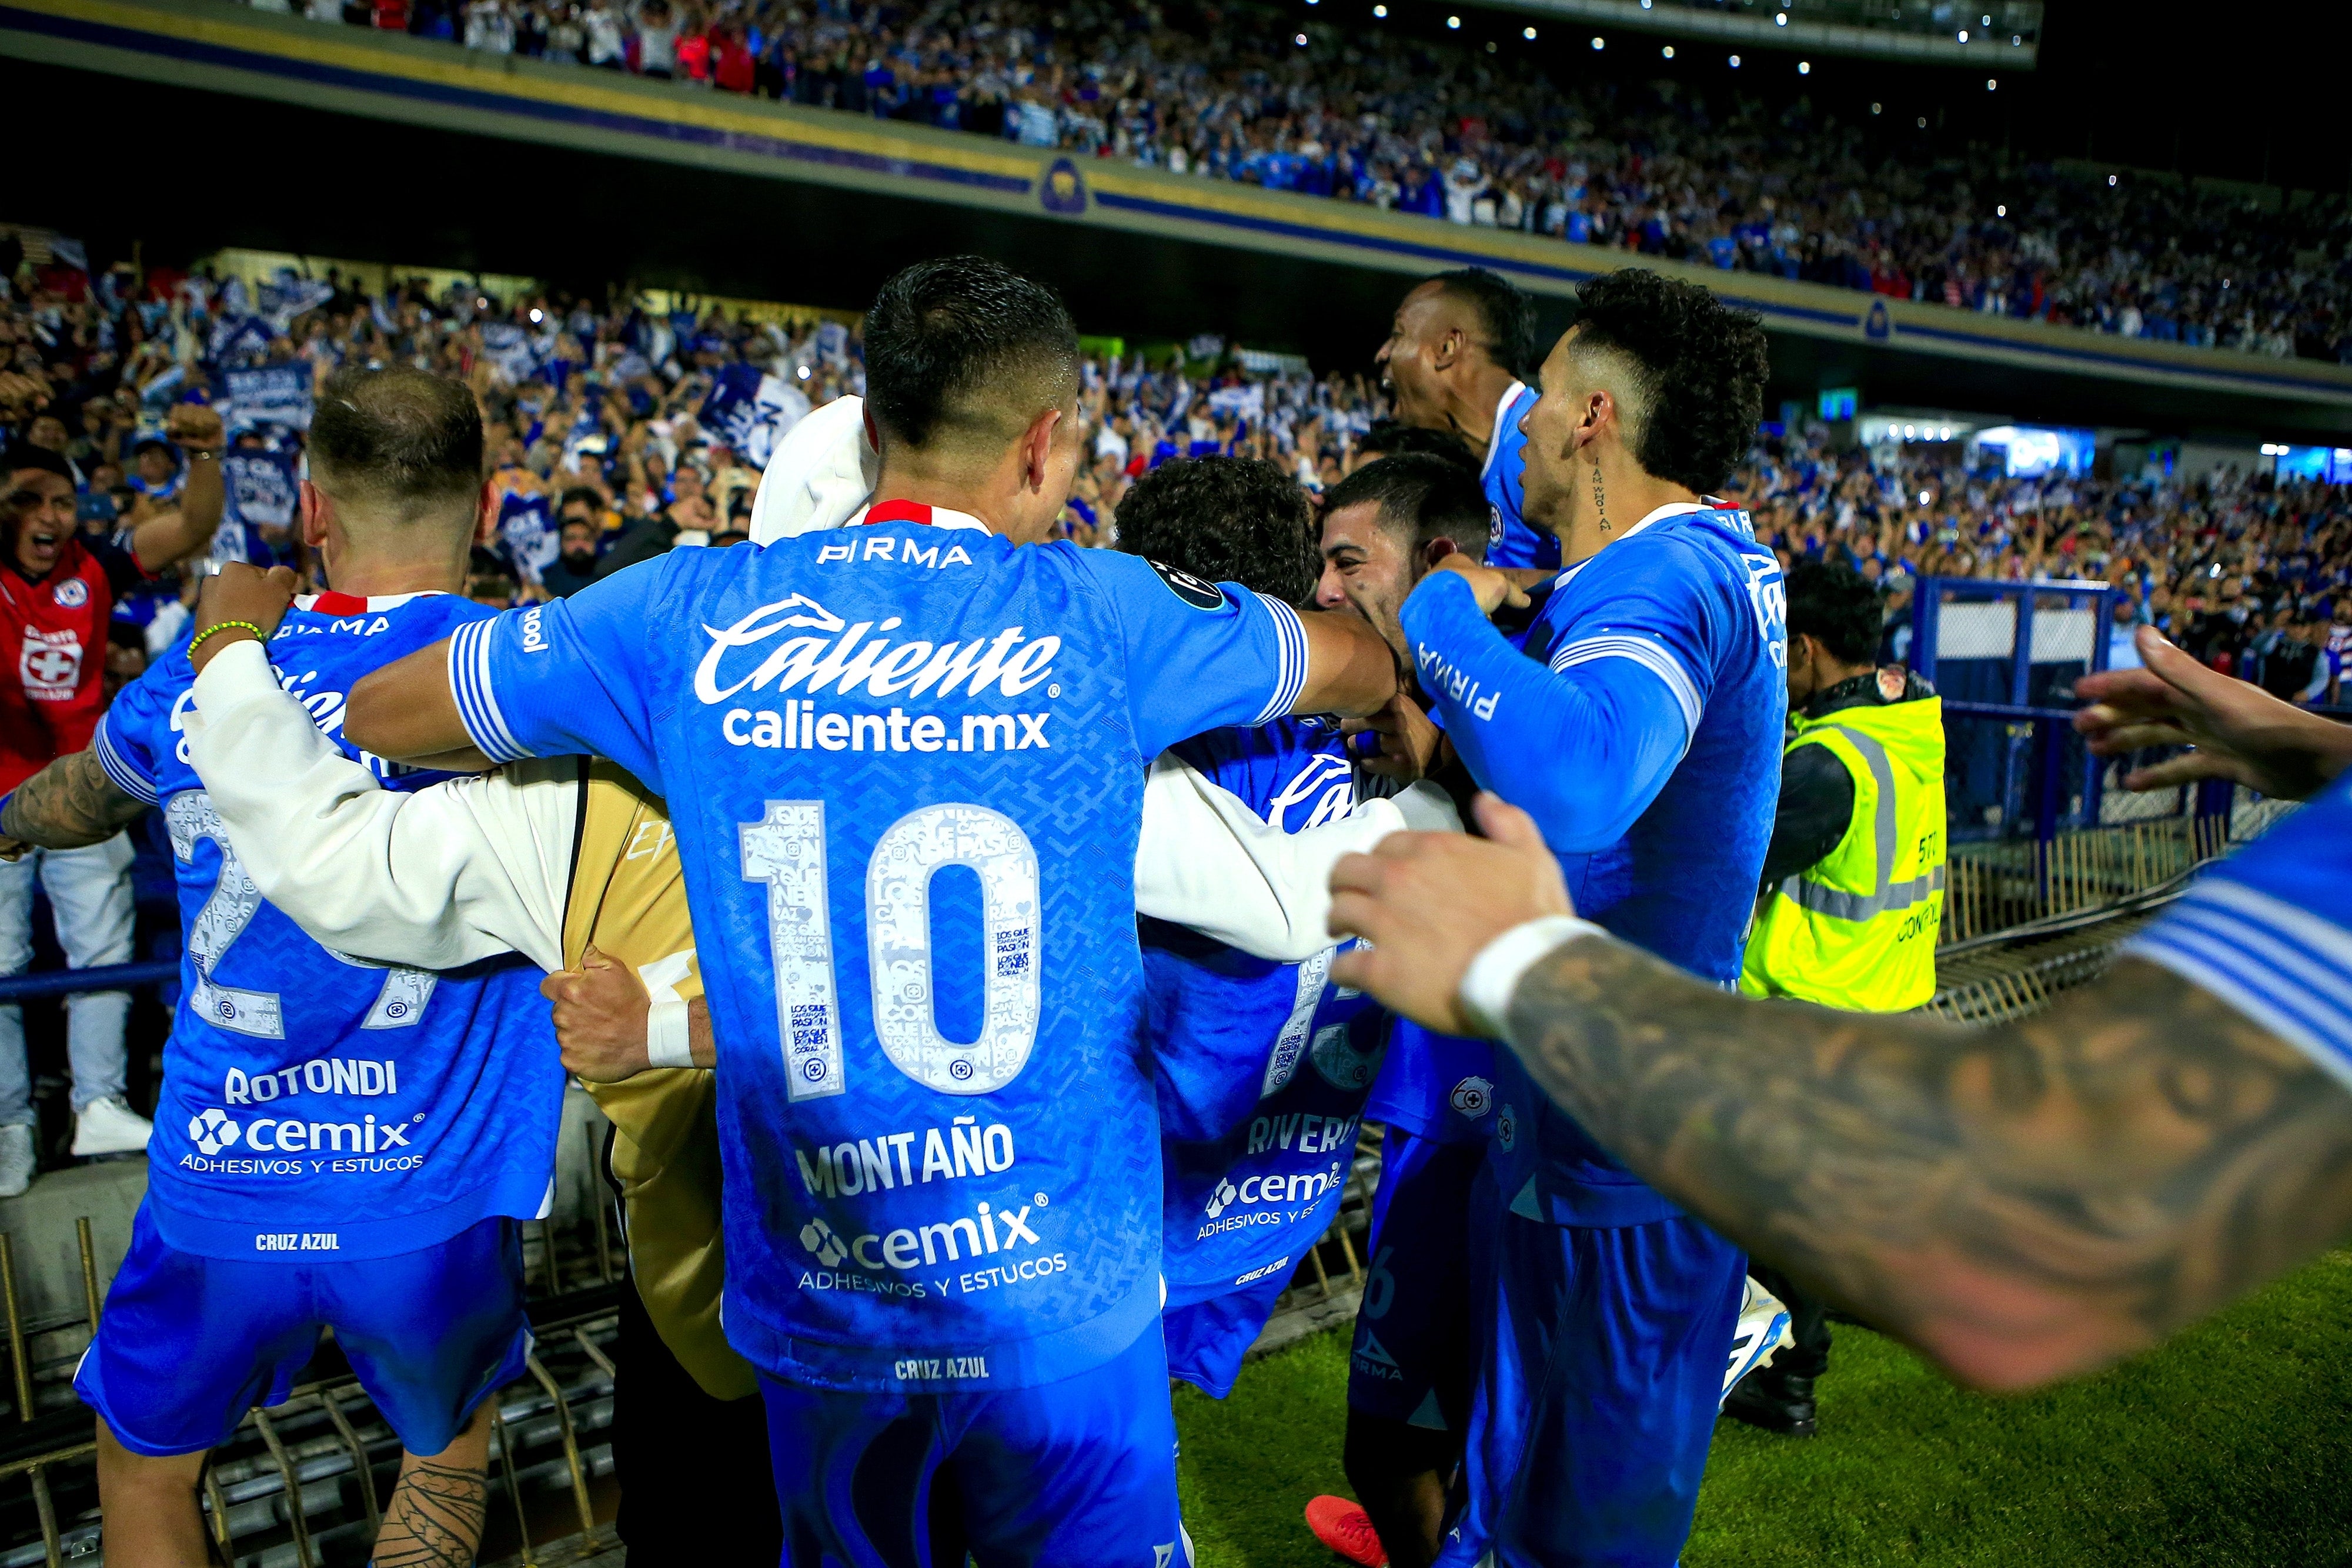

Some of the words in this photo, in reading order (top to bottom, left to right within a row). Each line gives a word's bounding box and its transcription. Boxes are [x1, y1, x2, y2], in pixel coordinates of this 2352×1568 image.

[816, 536, 973, 570] PIRMA
[694, 592, 1062, 705] Caliente
[1418, 641, 1502, 722] PIRMA
[722, 699, 1052, 753] caliente.mx
[737, 800, 1041, 1102] 10
[997, 931, 1011, 940] LOS
[225, 1058, 397, 1104] ROTONDI
[246, 1114, 412, 1154] cemix
[179, 1153, 303, 1175] ADHESIVOS
[310, 1160, 326, 1174] Y
[332, 1155, 424, 1174] ESTUCOS
[795, 1115, 1015, 1199] MONTAÑO
[1238, 1161, 1342, 1205] cemi
[256, 1233, 298, 1251] CRUZ
[299, 1233, 340, 1251] AZUL
[851, 1201, 1041, 1271] cemix
[1196, 1210, 1281, 1242] ADHESIVOS
[1287, 1211, 1299, 1224] Y
[797, 1271, 927, 1298] ADHESIVOS
[934, 1278, 951, 1298] Y
[959, 1252, 1068, 1293] ESTUCOS
[1235, 1261, 1265, 1286] CRUZ
[1262, 1255, 1290, 1277] AZUL
[894, 1359, 942, 1380] CRUZ
[946, 1356, 990, 1379] AZUL
